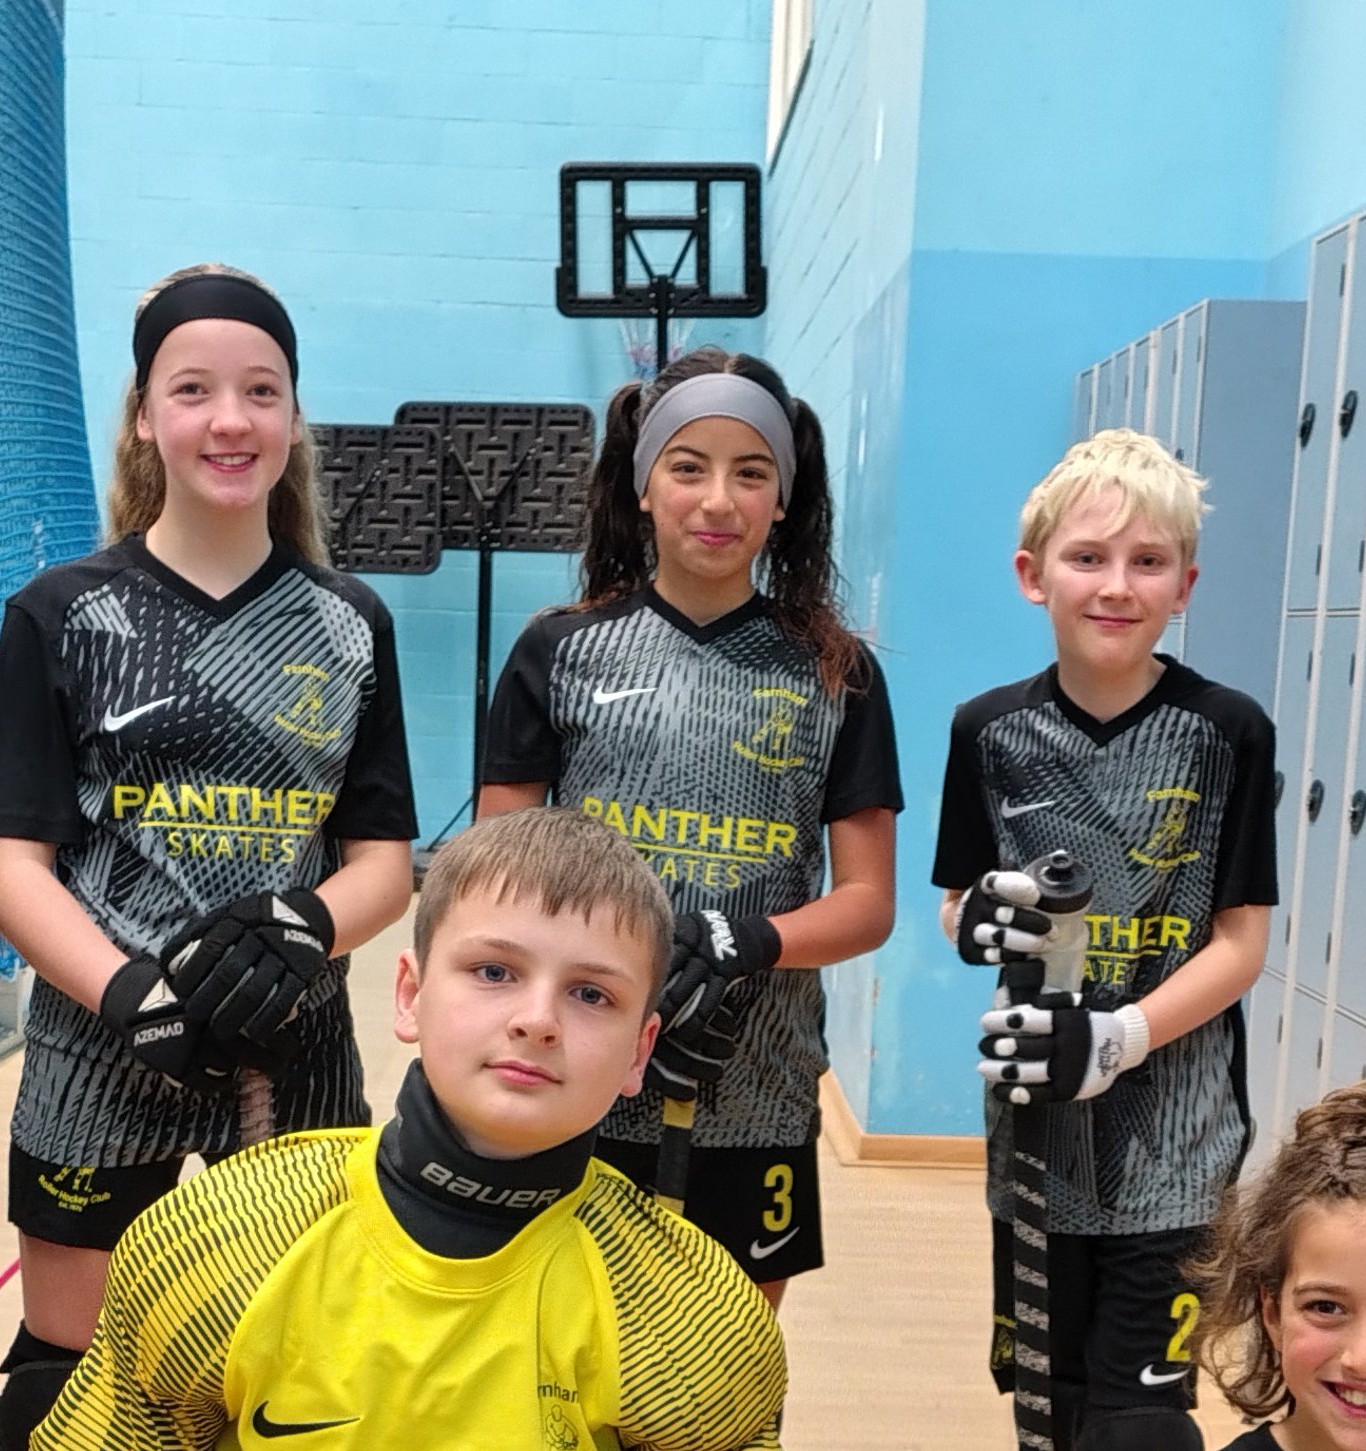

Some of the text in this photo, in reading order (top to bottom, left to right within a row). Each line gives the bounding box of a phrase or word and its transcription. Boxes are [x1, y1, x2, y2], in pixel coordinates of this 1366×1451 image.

[113, 783, 336, 825] PANTHER
[583, 796, 797, 857] PANTHER
[168, 831, 296, 863] SKATES
[645, 853, 741, 889] ATES
[1085, 914, 1192, 950] THER
[134, 1020, 184, 1047] AZEMAD
[763, 1163, 794, 1232] 3
[1166, 1293, 1200, 1361] 2
